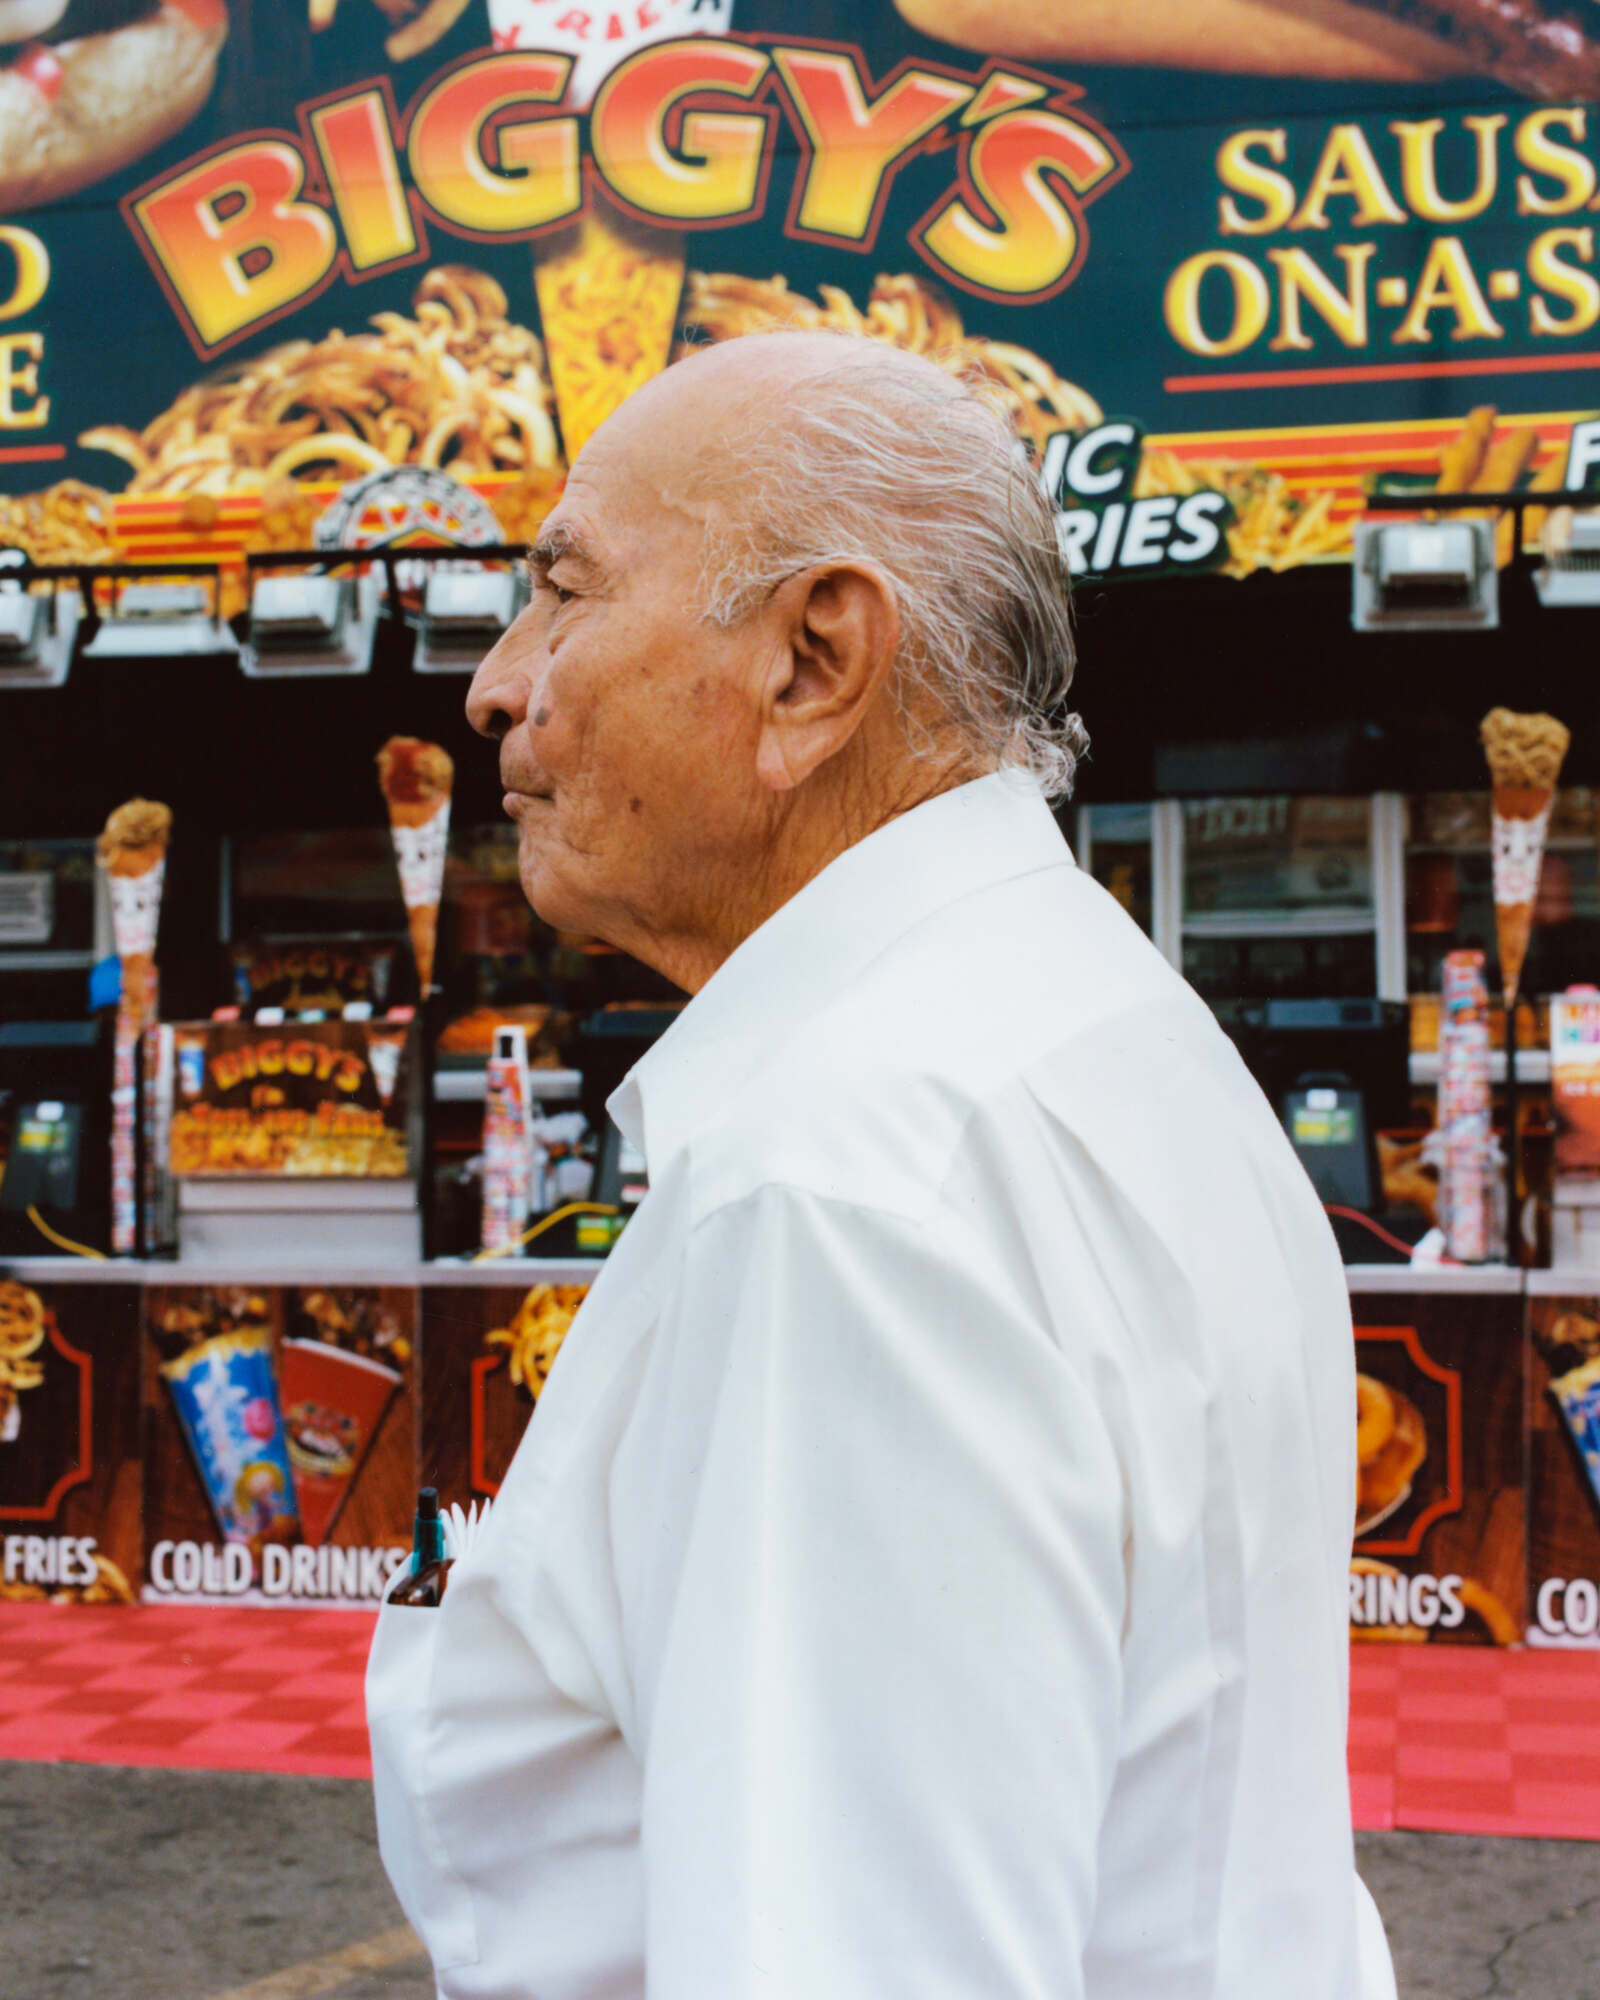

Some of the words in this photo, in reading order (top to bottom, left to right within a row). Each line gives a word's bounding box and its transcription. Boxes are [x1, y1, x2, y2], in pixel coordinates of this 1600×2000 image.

[122, 32, 1130, 360] BIGGY'S
[1216, 107, 1600, 236] SAUS
[4, 1534, 99, 1586] FRIES
[151, 1539, 254, 1595] COLD
[1536, 1577, 1600, 1636] CO
